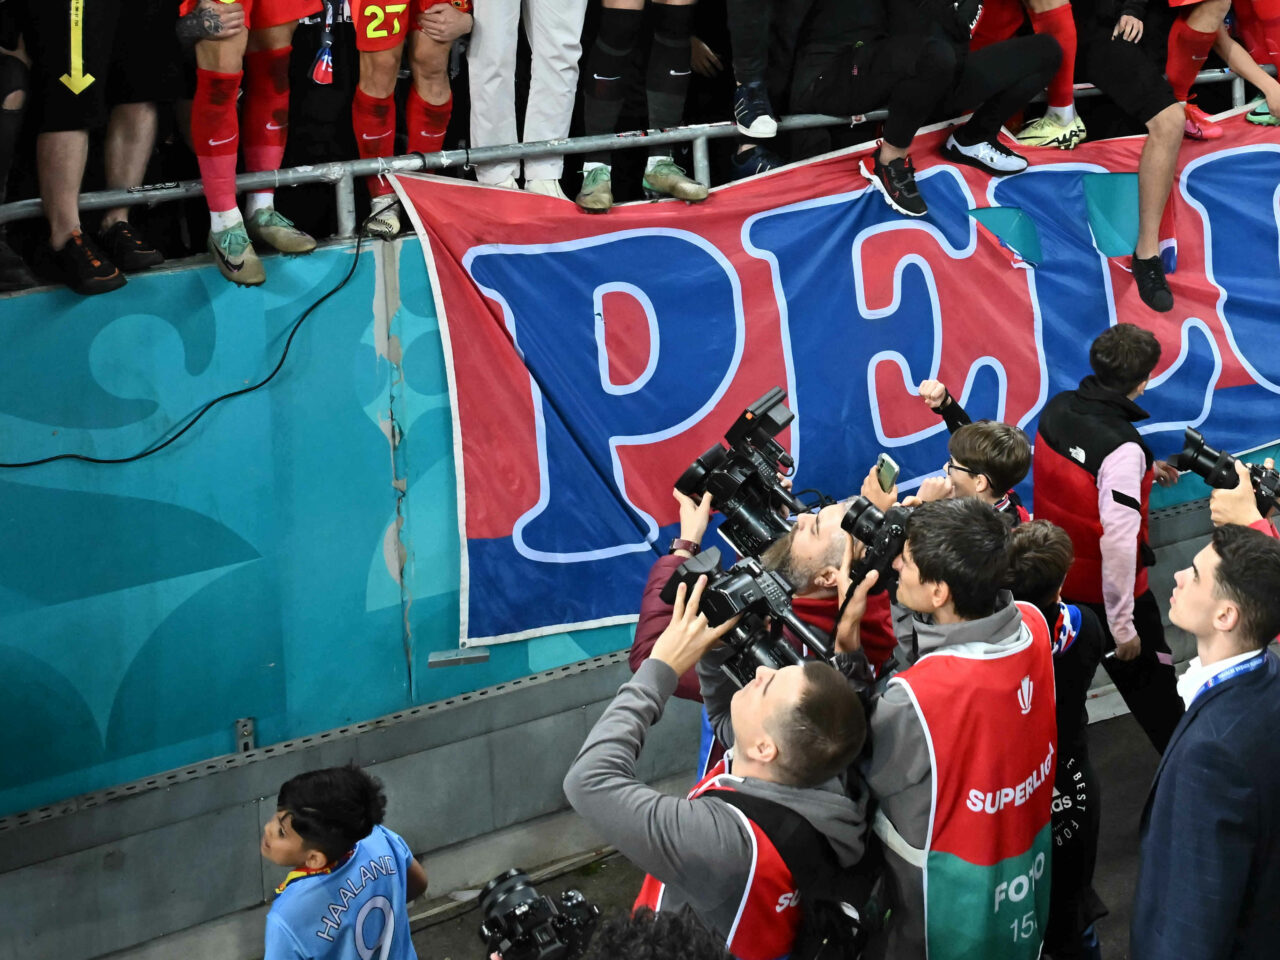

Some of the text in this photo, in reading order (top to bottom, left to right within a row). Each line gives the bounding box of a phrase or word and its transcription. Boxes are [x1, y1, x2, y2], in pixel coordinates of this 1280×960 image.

[363, 3, 407, 39] 27
[1072, 771, 1087, 811] BEST
[316, 854, 397, 942] HAALAND
[994, 851, 1045, 914] FOTO
[354, 895, 396, 960] 9
